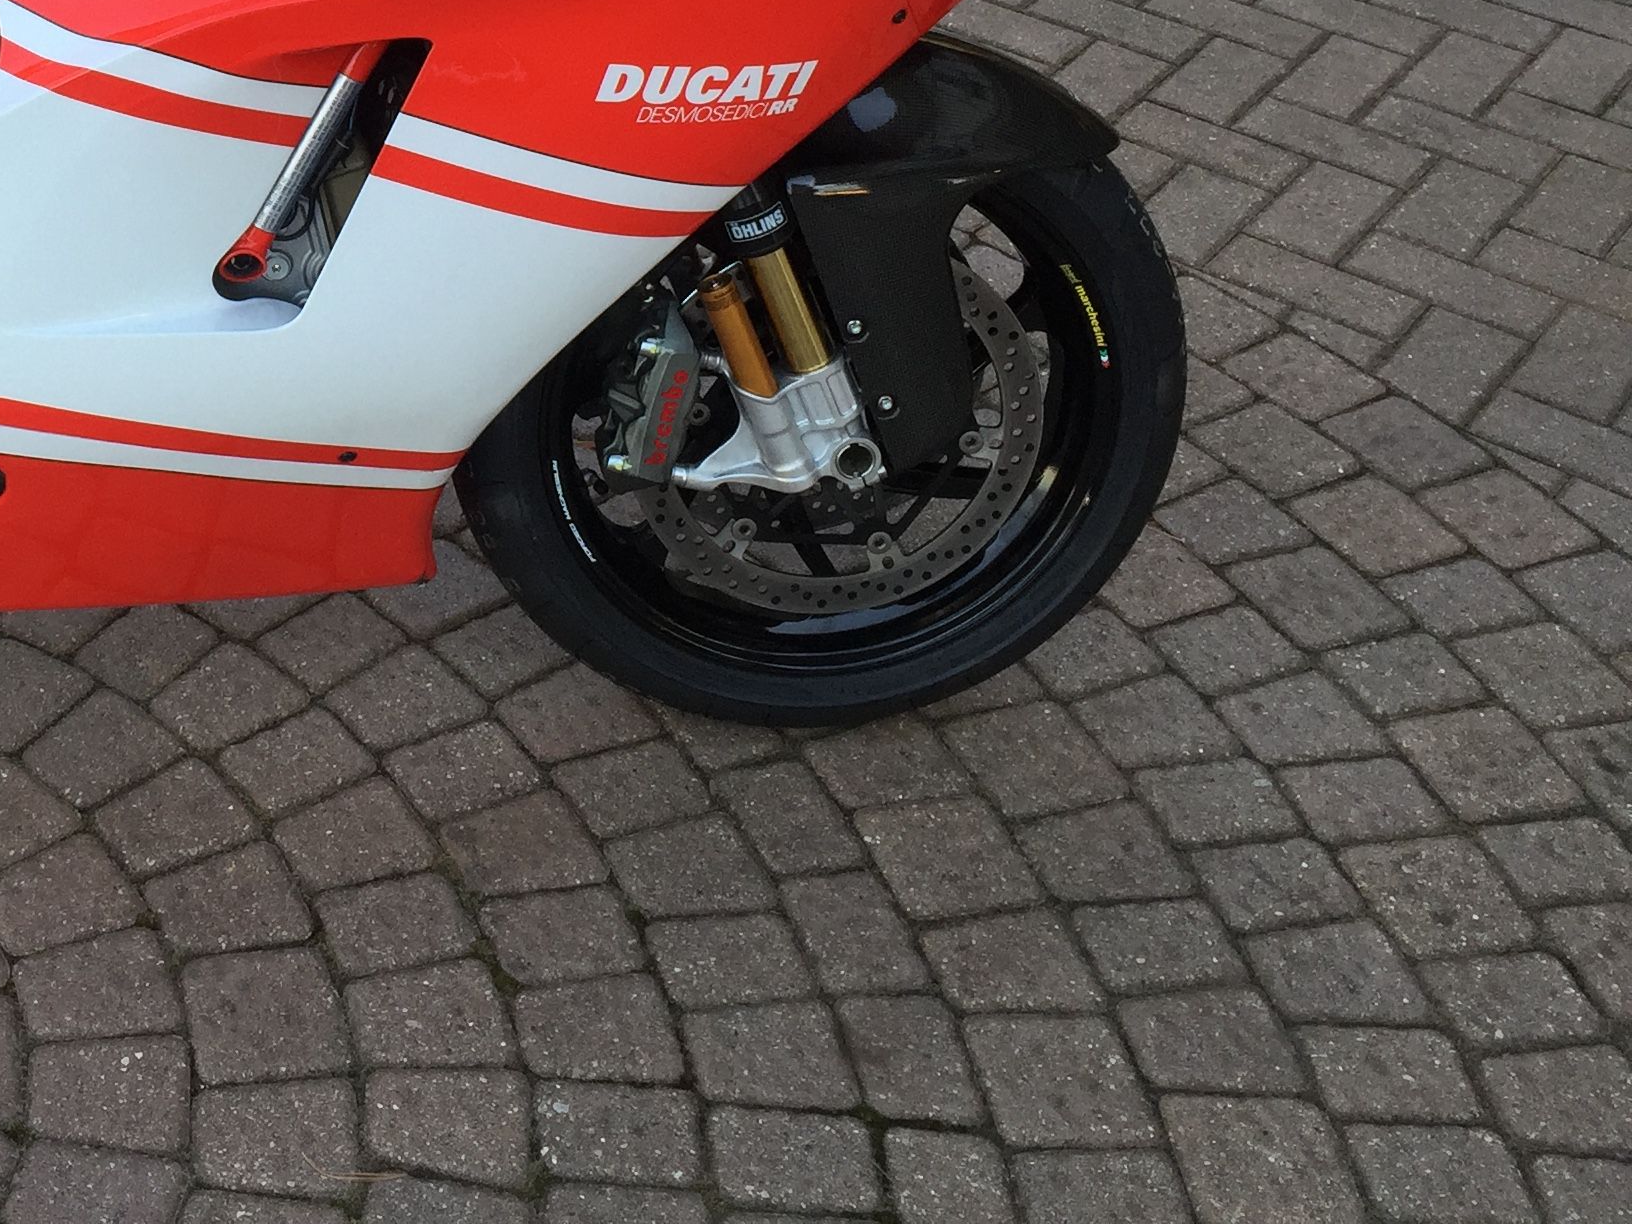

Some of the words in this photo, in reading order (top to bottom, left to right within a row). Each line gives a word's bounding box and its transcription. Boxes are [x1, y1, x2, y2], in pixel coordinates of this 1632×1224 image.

[594, 59, 819, 105] DUCATI
[730, 208, 785, 240] ÖHLINS
[1074, 285, 1108, 347] marchesini
[644, 369, 689, 465] brembo
